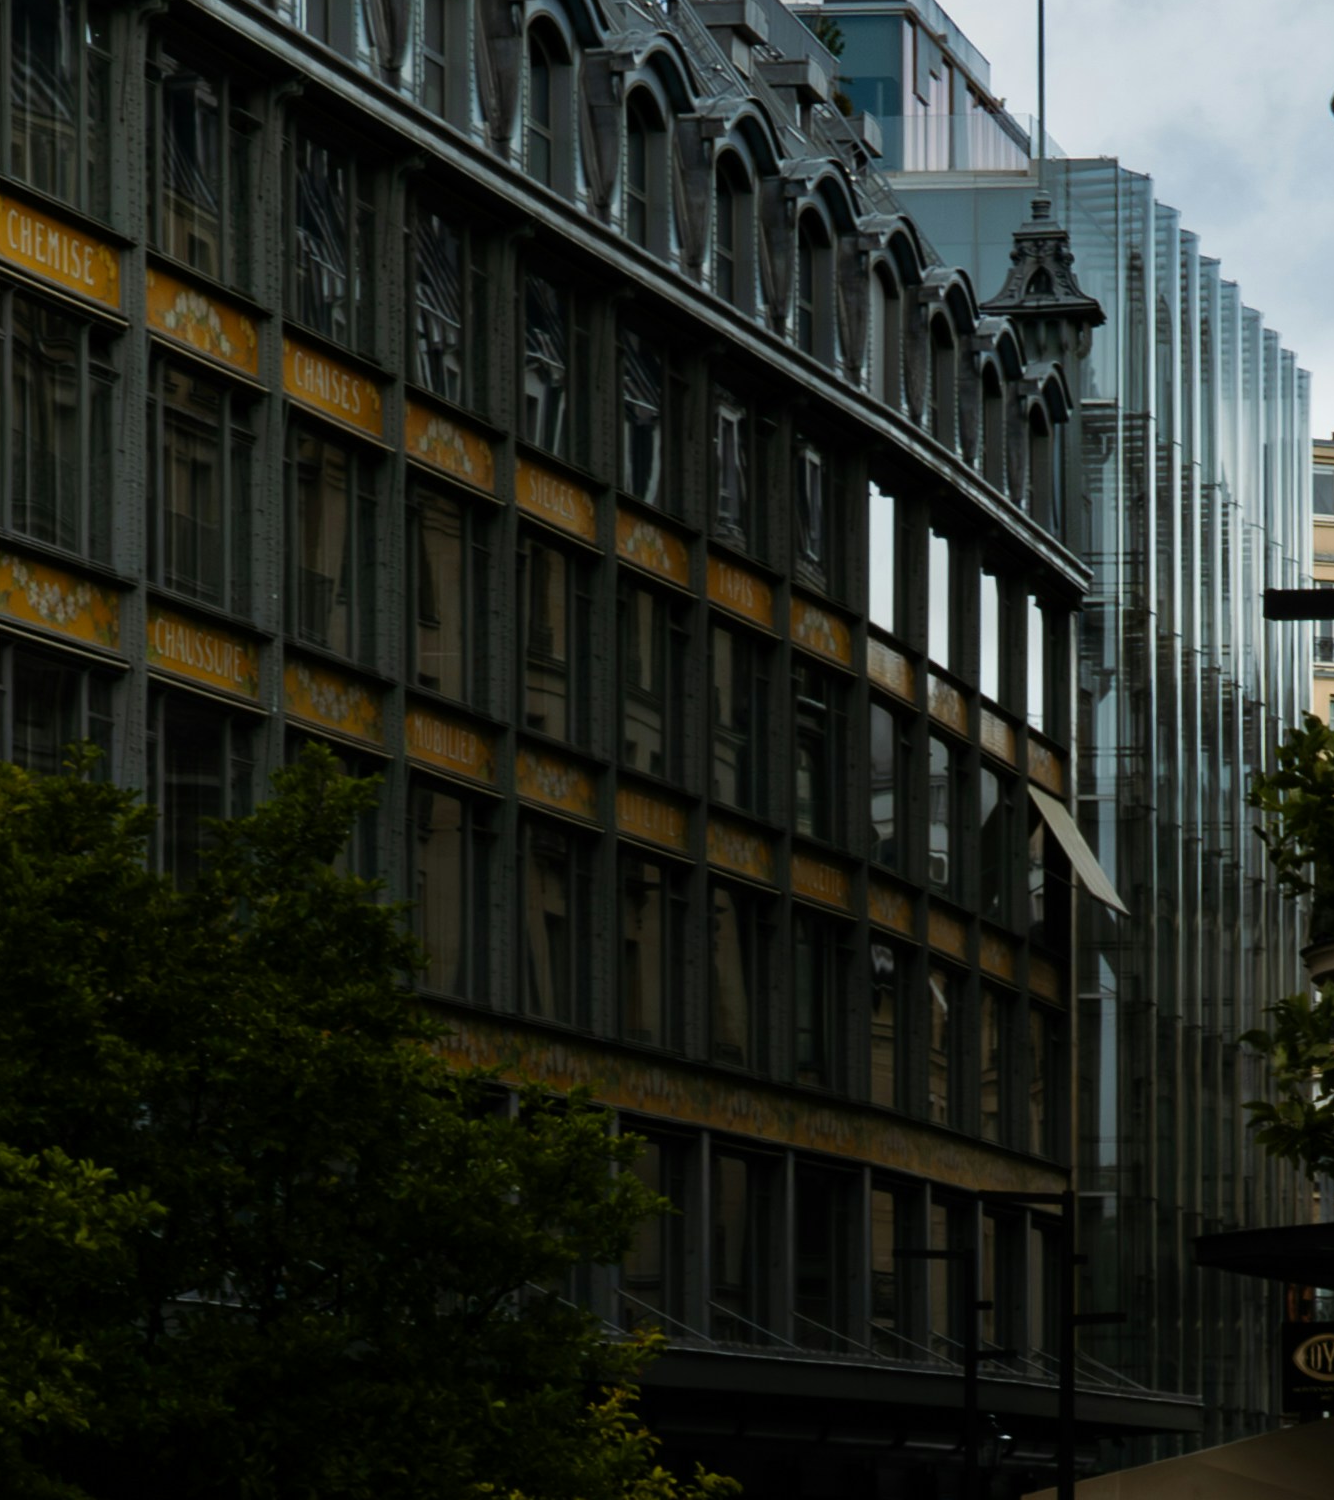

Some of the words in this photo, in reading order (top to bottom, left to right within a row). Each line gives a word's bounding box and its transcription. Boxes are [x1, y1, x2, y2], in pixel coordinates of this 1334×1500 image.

[6, 208, 96, 285] CHEMISE
[294, 353, 361, 414] CHAISES
[718, 562, 754, 608] TAPIS
[154, 618, 244, 682] CHAUSSURE
[414, 713, 476, 765] MOBILIER
